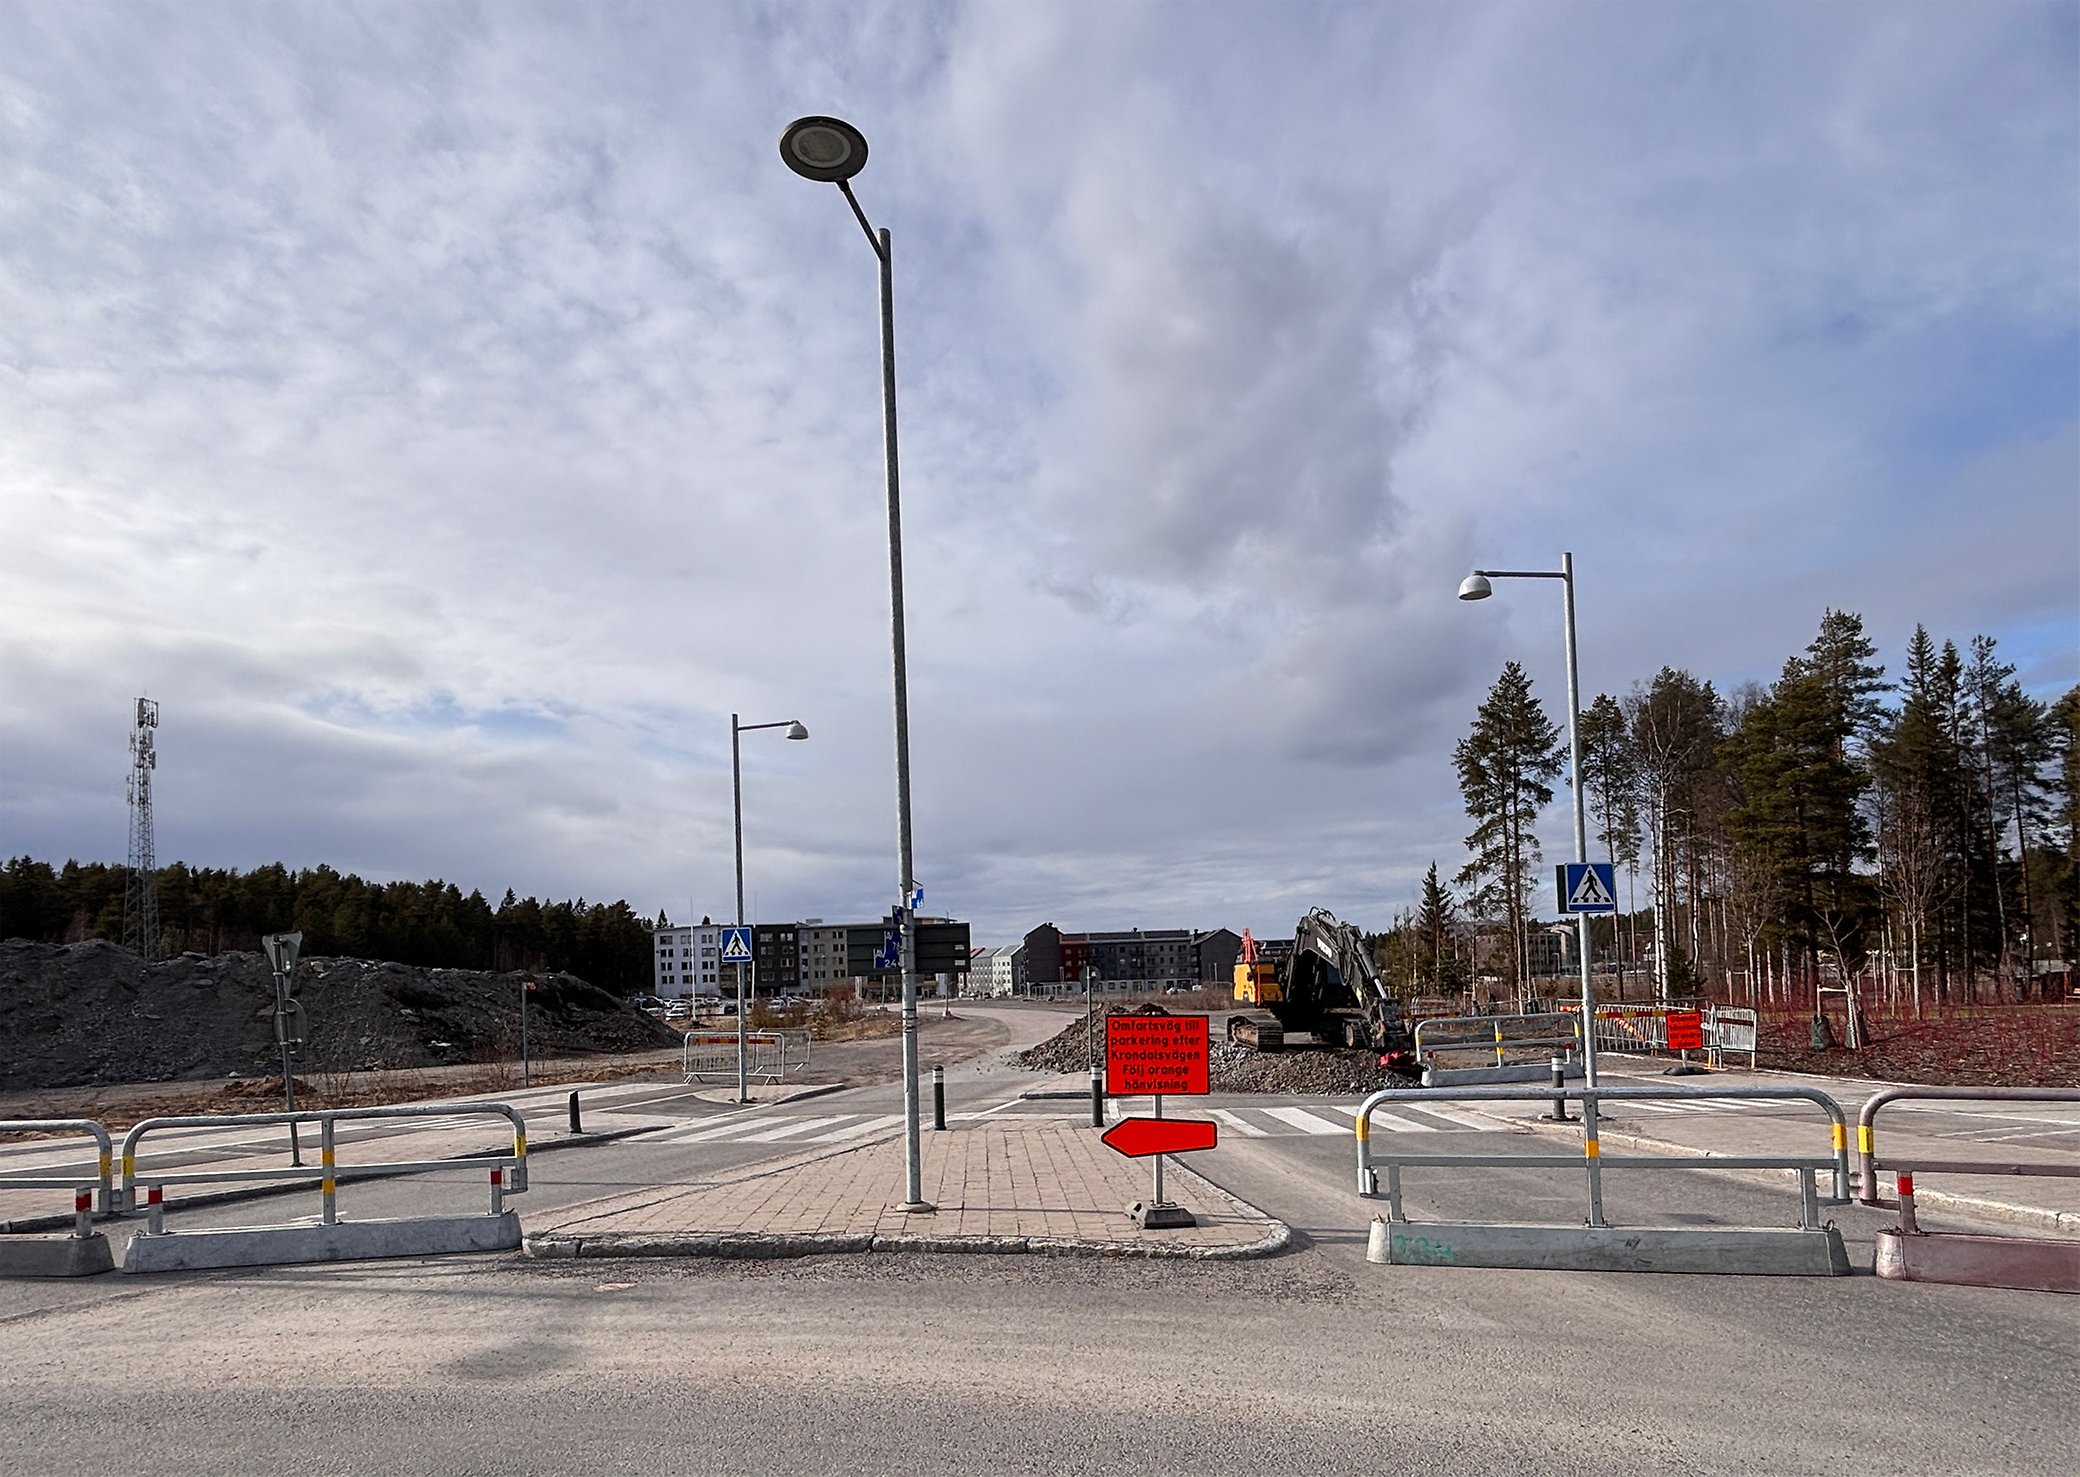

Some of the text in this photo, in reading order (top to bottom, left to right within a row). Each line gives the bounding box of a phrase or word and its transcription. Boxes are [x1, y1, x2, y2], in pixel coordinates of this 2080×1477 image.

[1112, 1020, 1199, 1032] Omfartsväg till
[1111, 1034, 1201, 1047] parkering efter
[1111, 1050, 1200, 1062] Krondalsvägen
[1123, 1064, 1189, 1076] Följ orange
[1124, 1080, 1188, 1091] hänvisning
